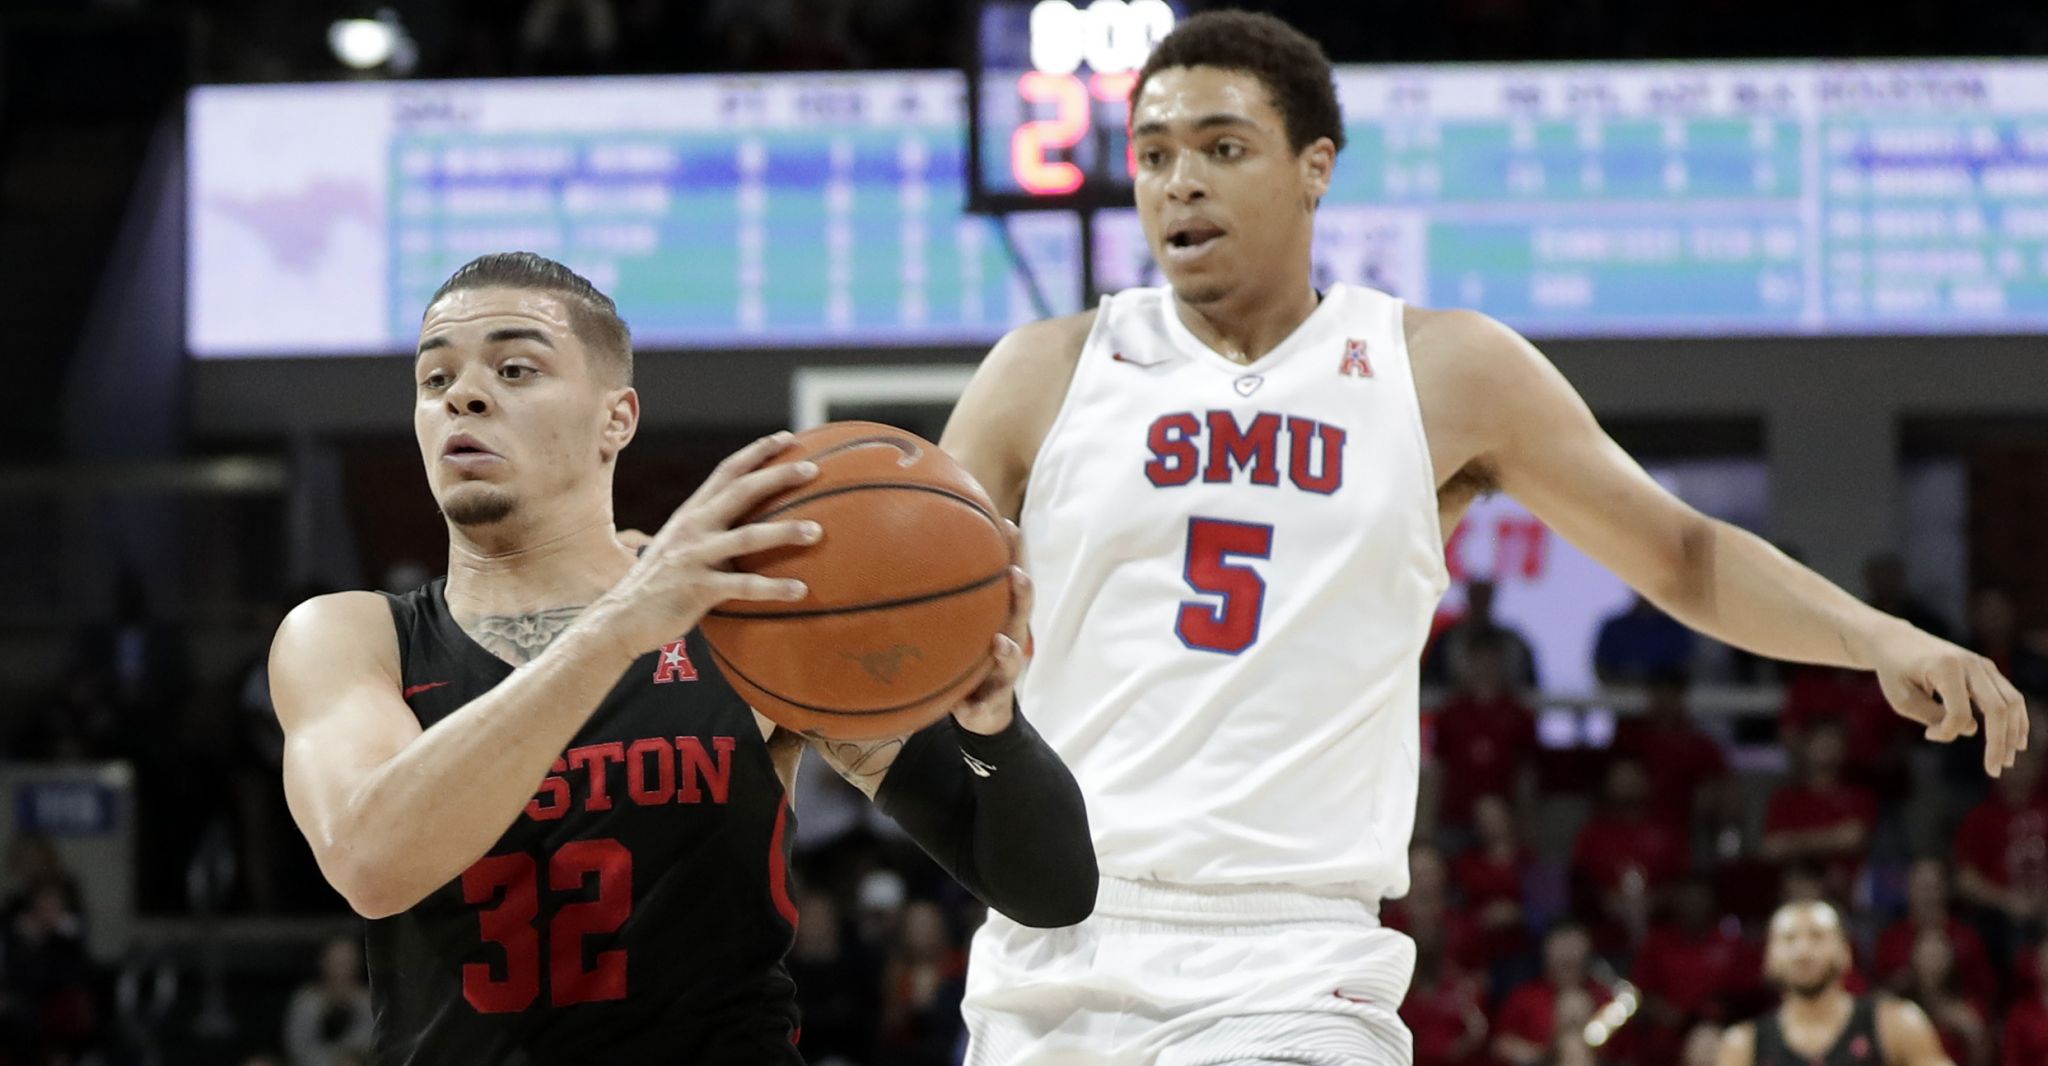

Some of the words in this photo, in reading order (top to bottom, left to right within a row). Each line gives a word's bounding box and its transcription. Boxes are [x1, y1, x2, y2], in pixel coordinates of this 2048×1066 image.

[1144, 409, 1347, 496] SMU
[1174, 516, 1275, 656] 5
[524, 736, 736, 822] STON
[461, 837, 634, 1014] 32
